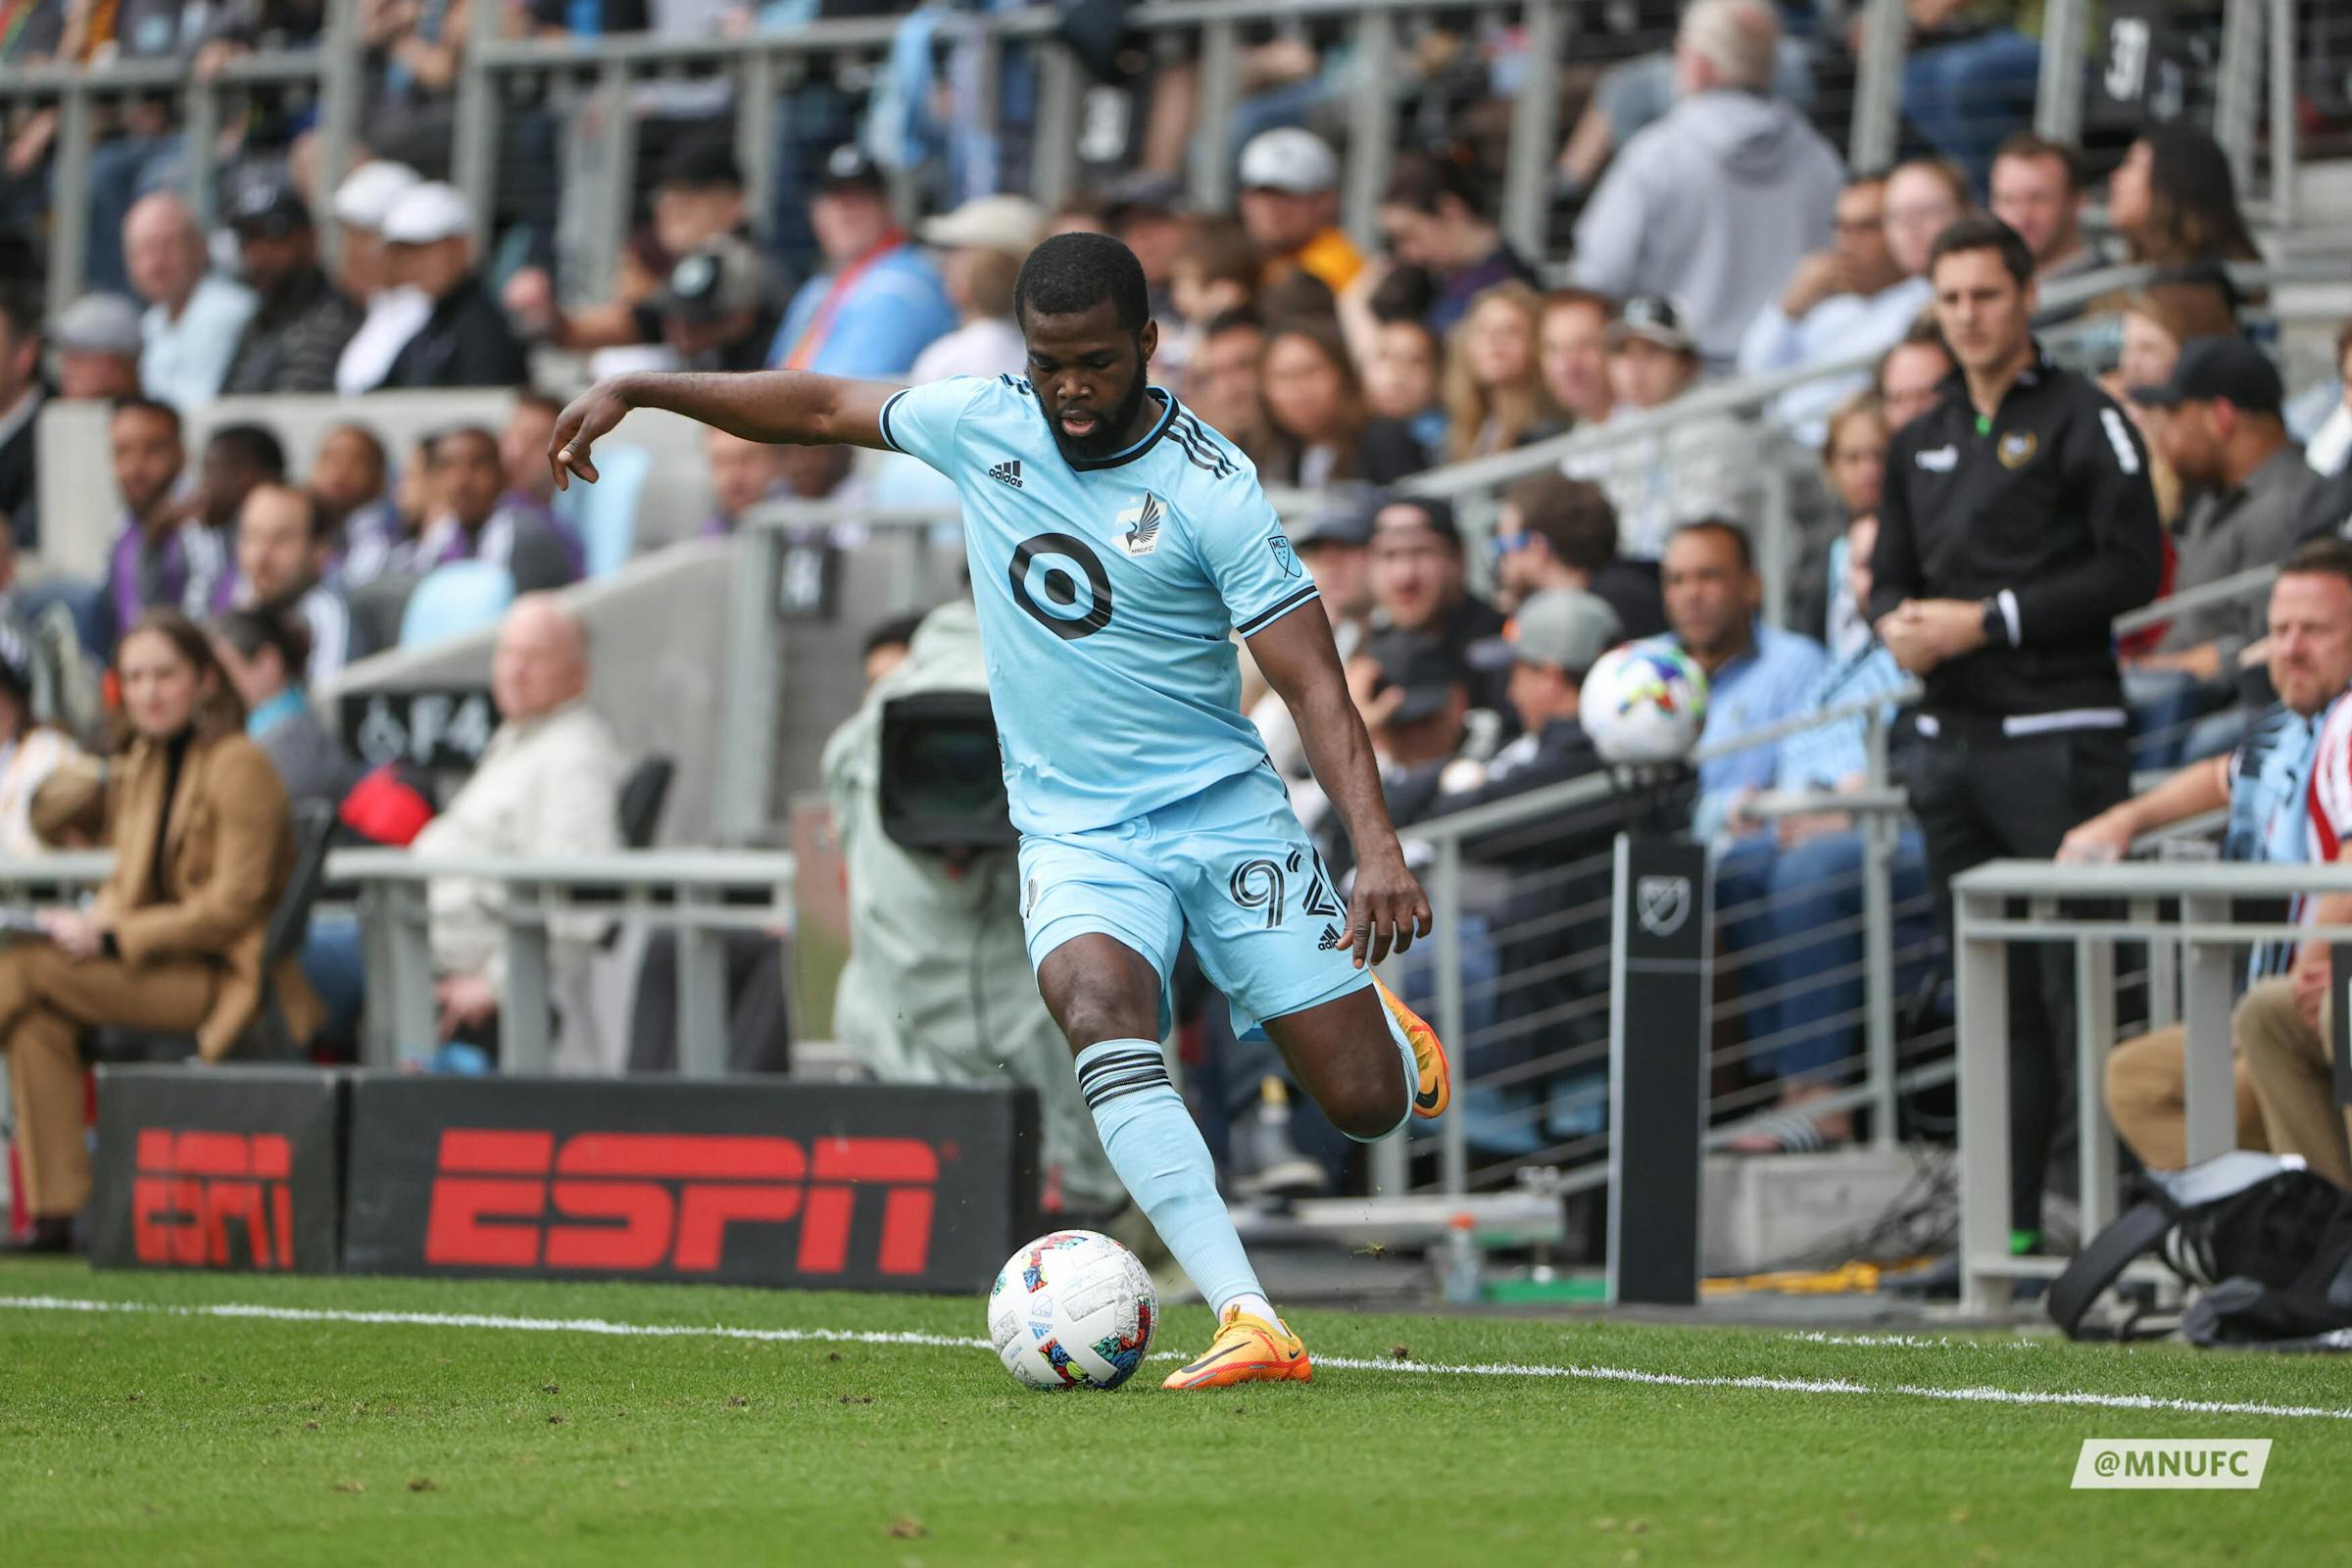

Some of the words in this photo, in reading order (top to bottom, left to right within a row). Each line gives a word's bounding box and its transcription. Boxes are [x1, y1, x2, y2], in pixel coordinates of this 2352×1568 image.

[989, 468, 1023, 488] adidas
[1271, 539, 1287, 549] MLS
[1229, 850, 1338, 929] 92
[133, 1128, 293, 1269] ESPN
[424, 1129, 938, 1273] ESPN
